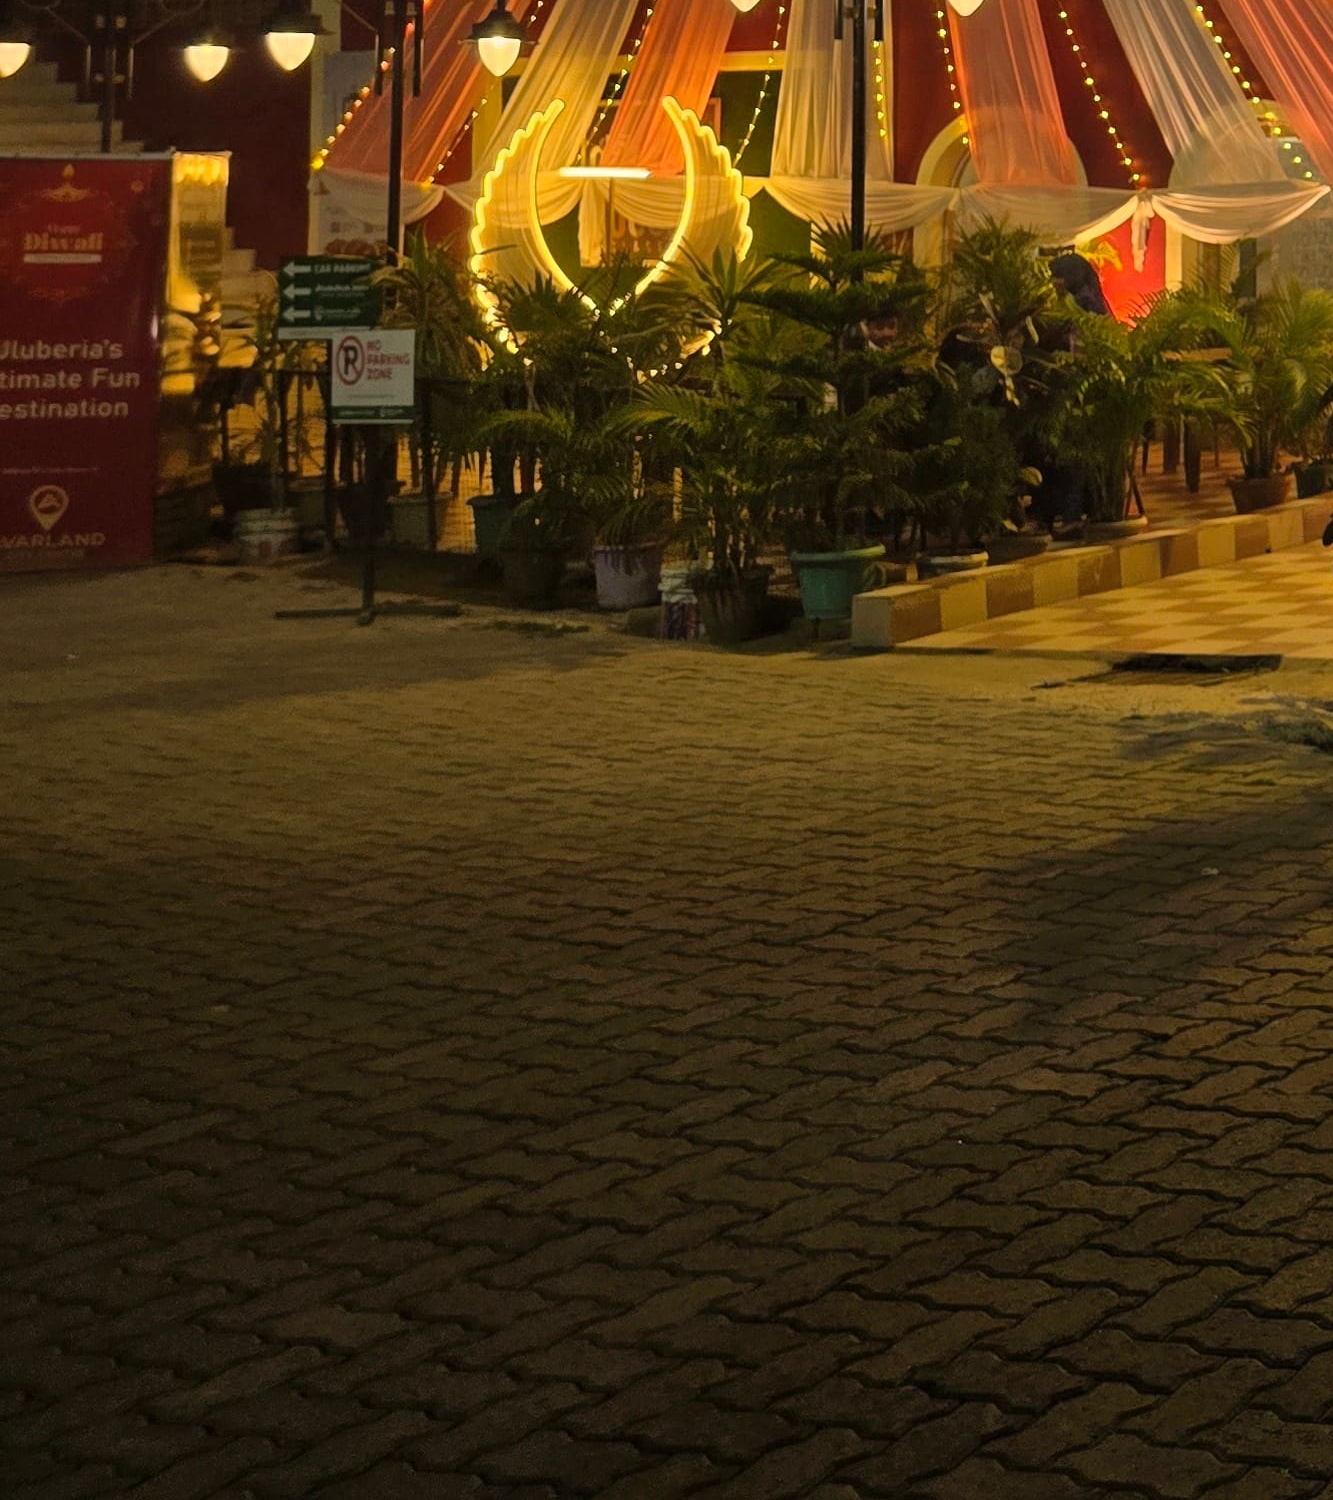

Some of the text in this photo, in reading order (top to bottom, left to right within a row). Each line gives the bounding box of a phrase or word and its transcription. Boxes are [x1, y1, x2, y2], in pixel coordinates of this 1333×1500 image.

[367, 353, 410, 366] PARKING
[0, 367, 140, 389] timate Fun
[367, 367, 393, 381] ZONE
[0, 398, 129, 420] estination
[0, 531, 106, 549] VARLAND
